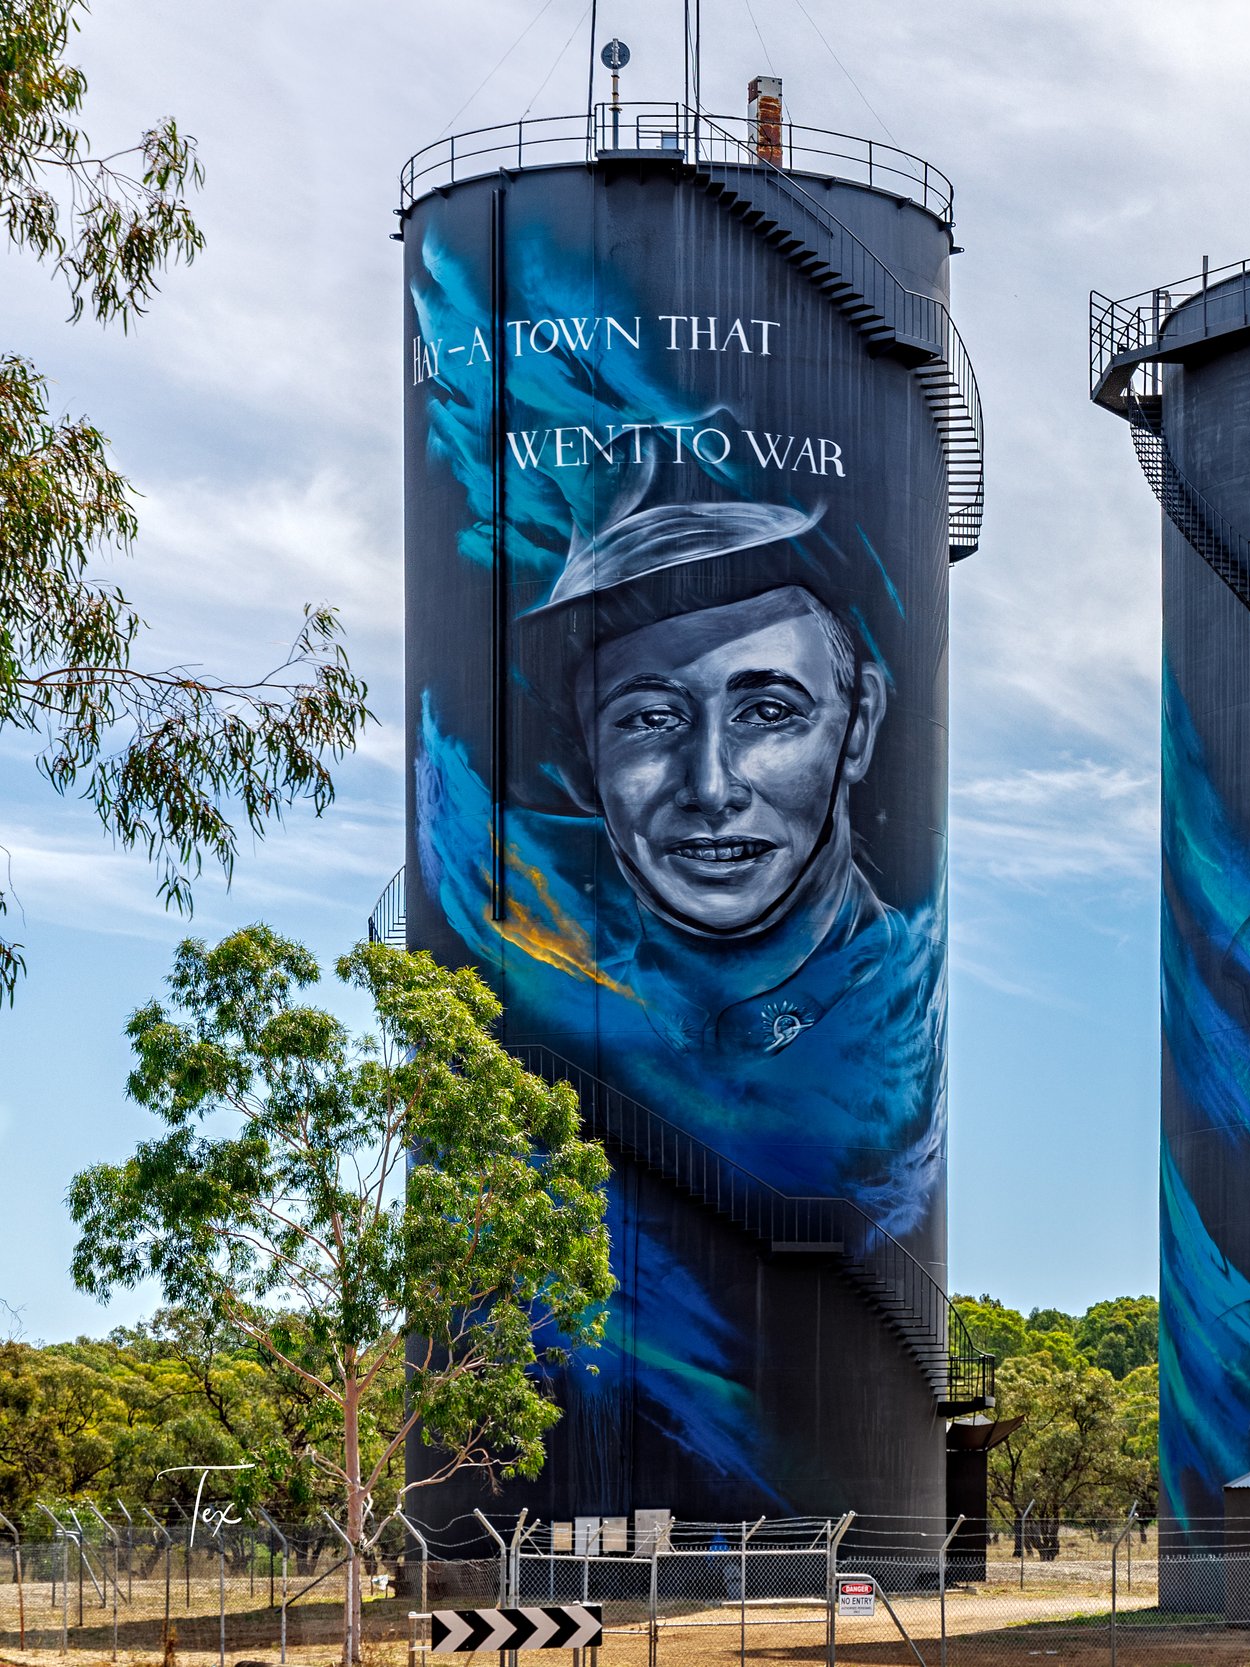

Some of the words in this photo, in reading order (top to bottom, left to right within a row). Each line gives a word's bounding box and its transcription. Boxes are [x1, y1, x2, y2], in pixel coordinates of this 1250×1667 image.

[507, 315, 641, 357] TOWN
[658, 315, 780, 356] THAT
[506, 424, 652, 470] WENT
[663, 424, 731, 465] TO
[741, 429, 846, 478] WAR
[841, 1597, 851, 1605] NO
[852, 1597, 873, 1605] ENTRY
